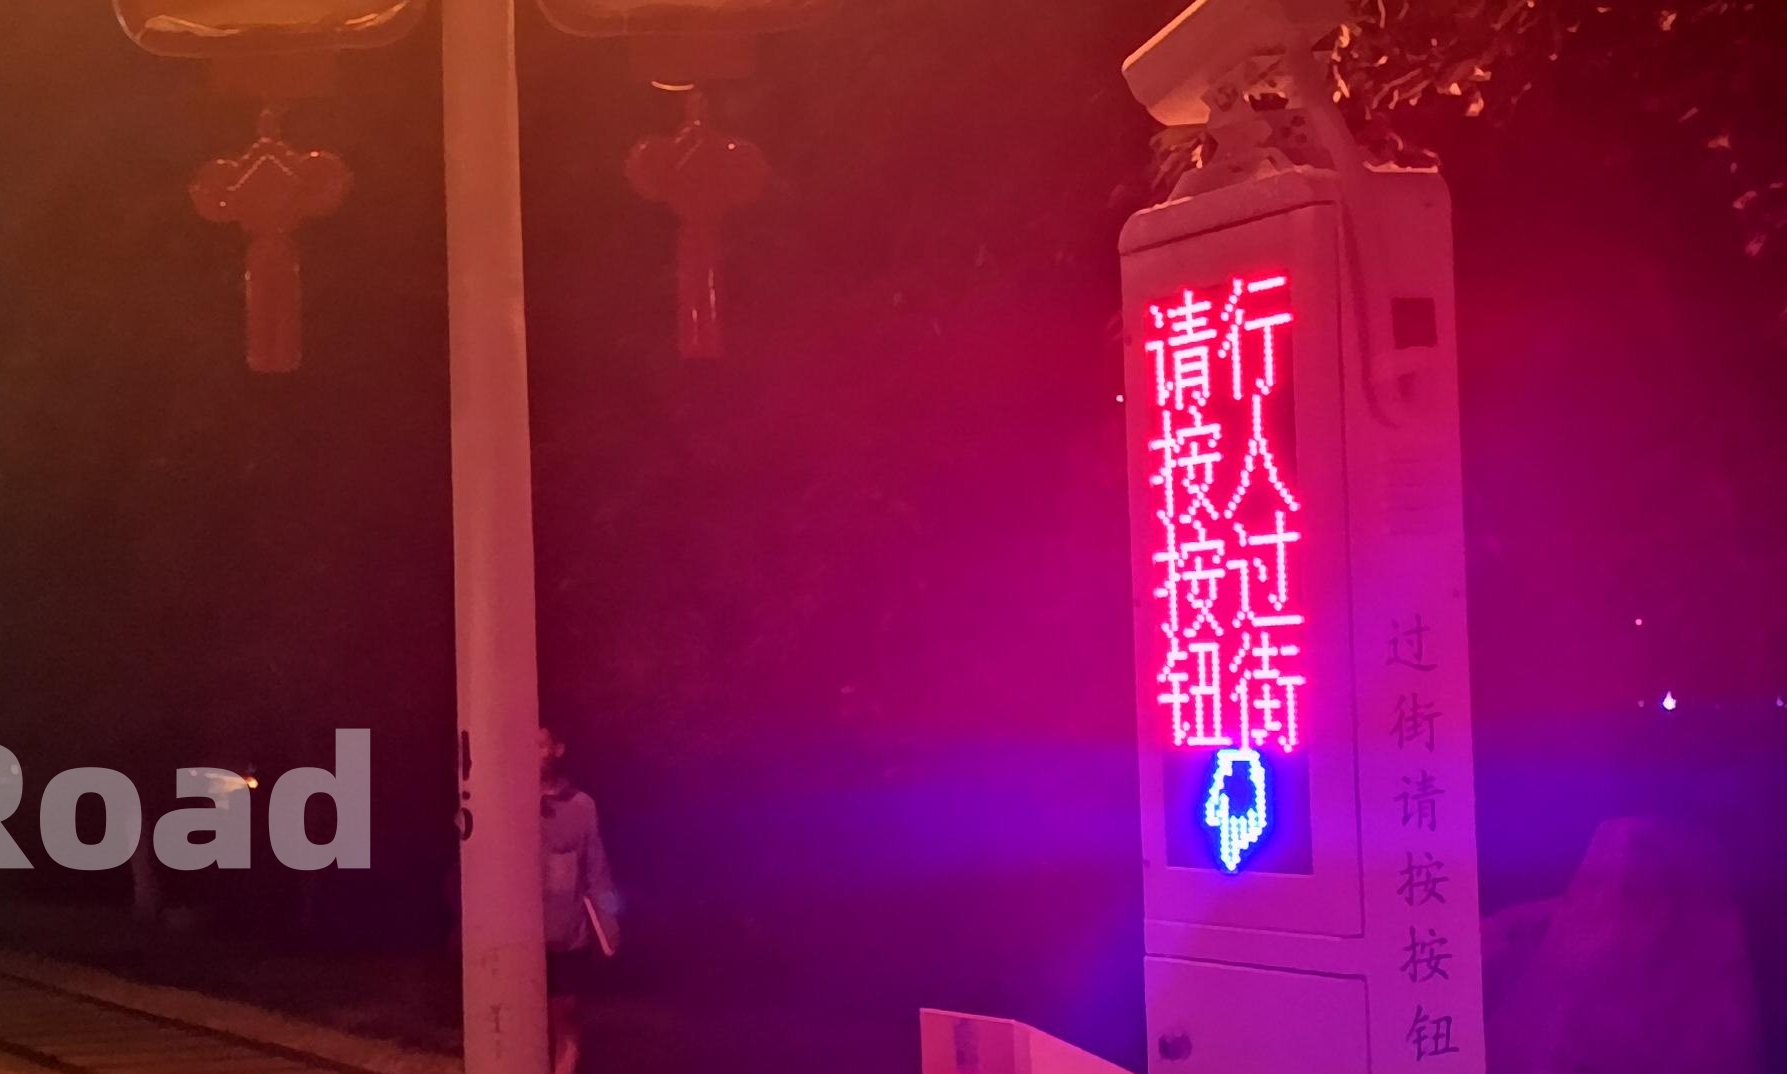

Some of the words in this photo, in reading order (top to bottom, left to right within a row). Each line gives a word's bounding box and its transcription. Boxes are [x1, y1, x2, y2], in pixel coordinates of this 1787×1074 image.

[1145, 288, 1232, 747] 请按按钮
[1218, 277, 1306, 754] 行人过街
[1385, 613, 1459, 1062] 过街请按按钮
